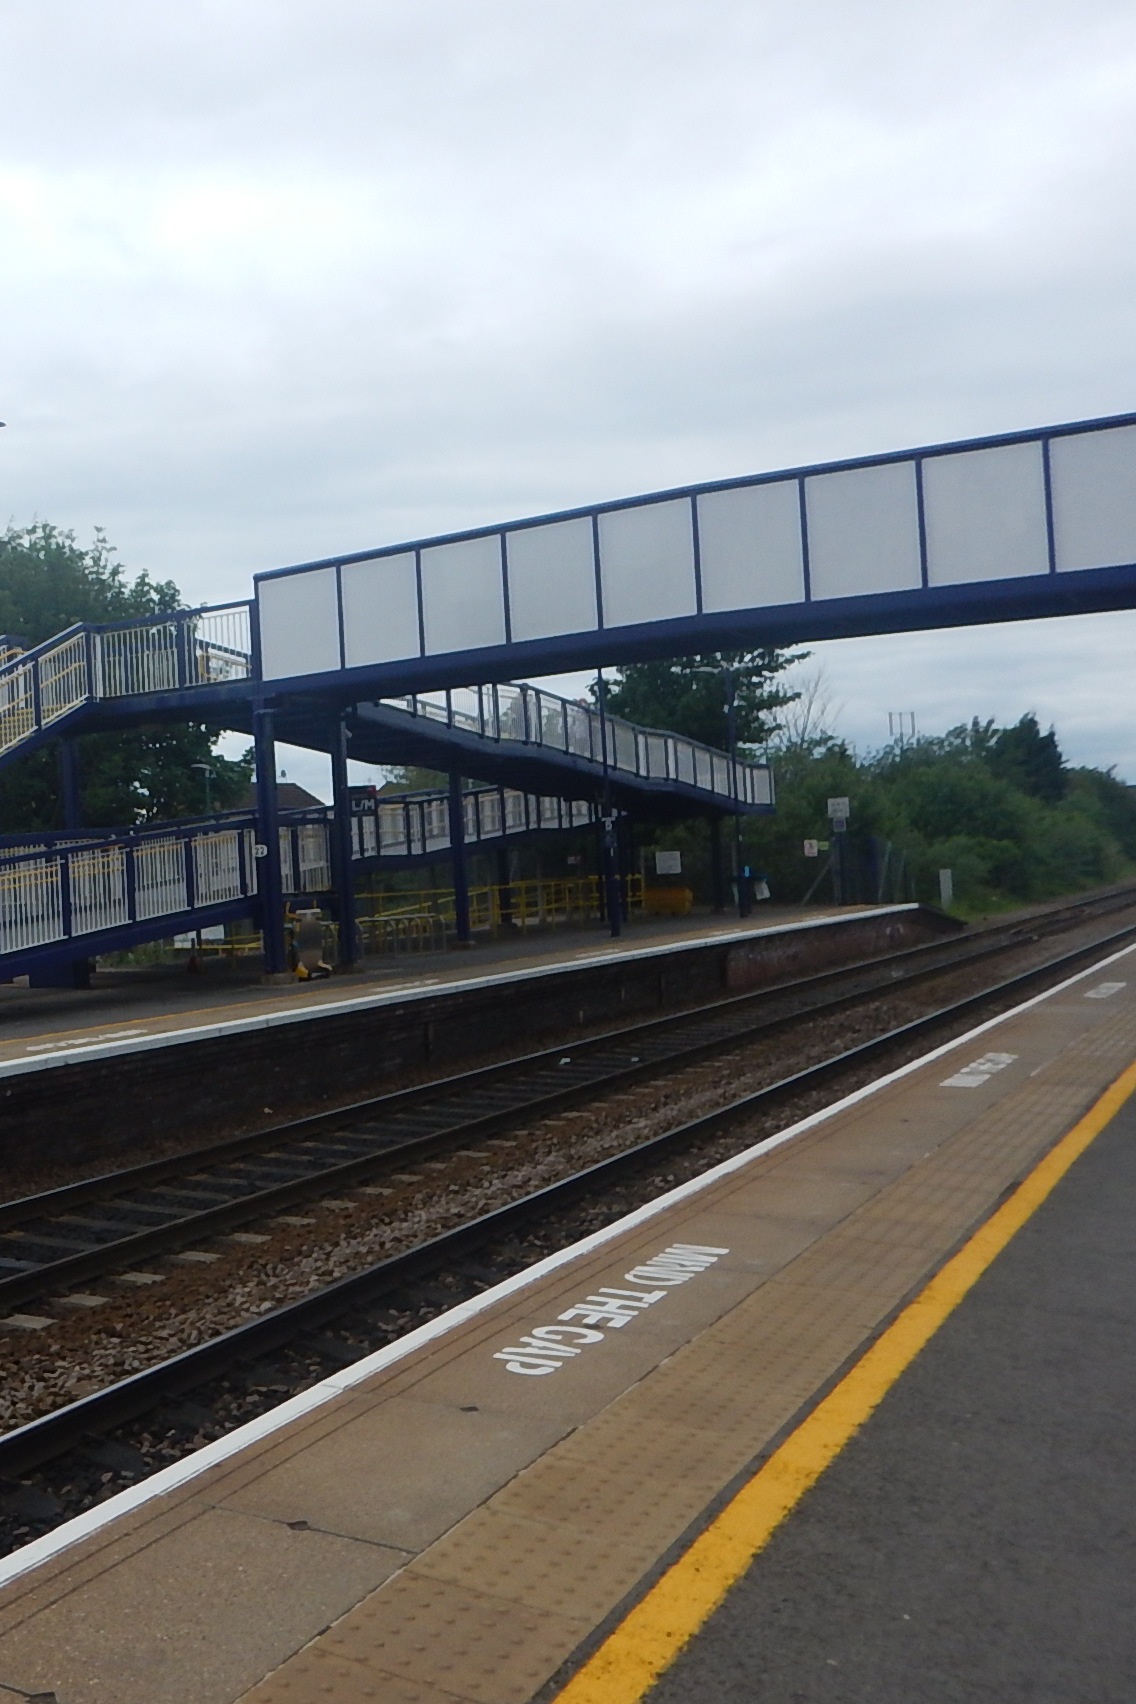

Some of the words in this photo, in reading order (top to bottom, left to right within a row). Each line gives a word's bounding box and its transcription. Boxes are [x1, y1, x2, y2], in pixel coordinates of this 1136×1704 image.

[624, 1243, 730, 1286] MIND
[557, 1287, 668, 1328] THE
[492, 1325, 605, 1376] GAP
